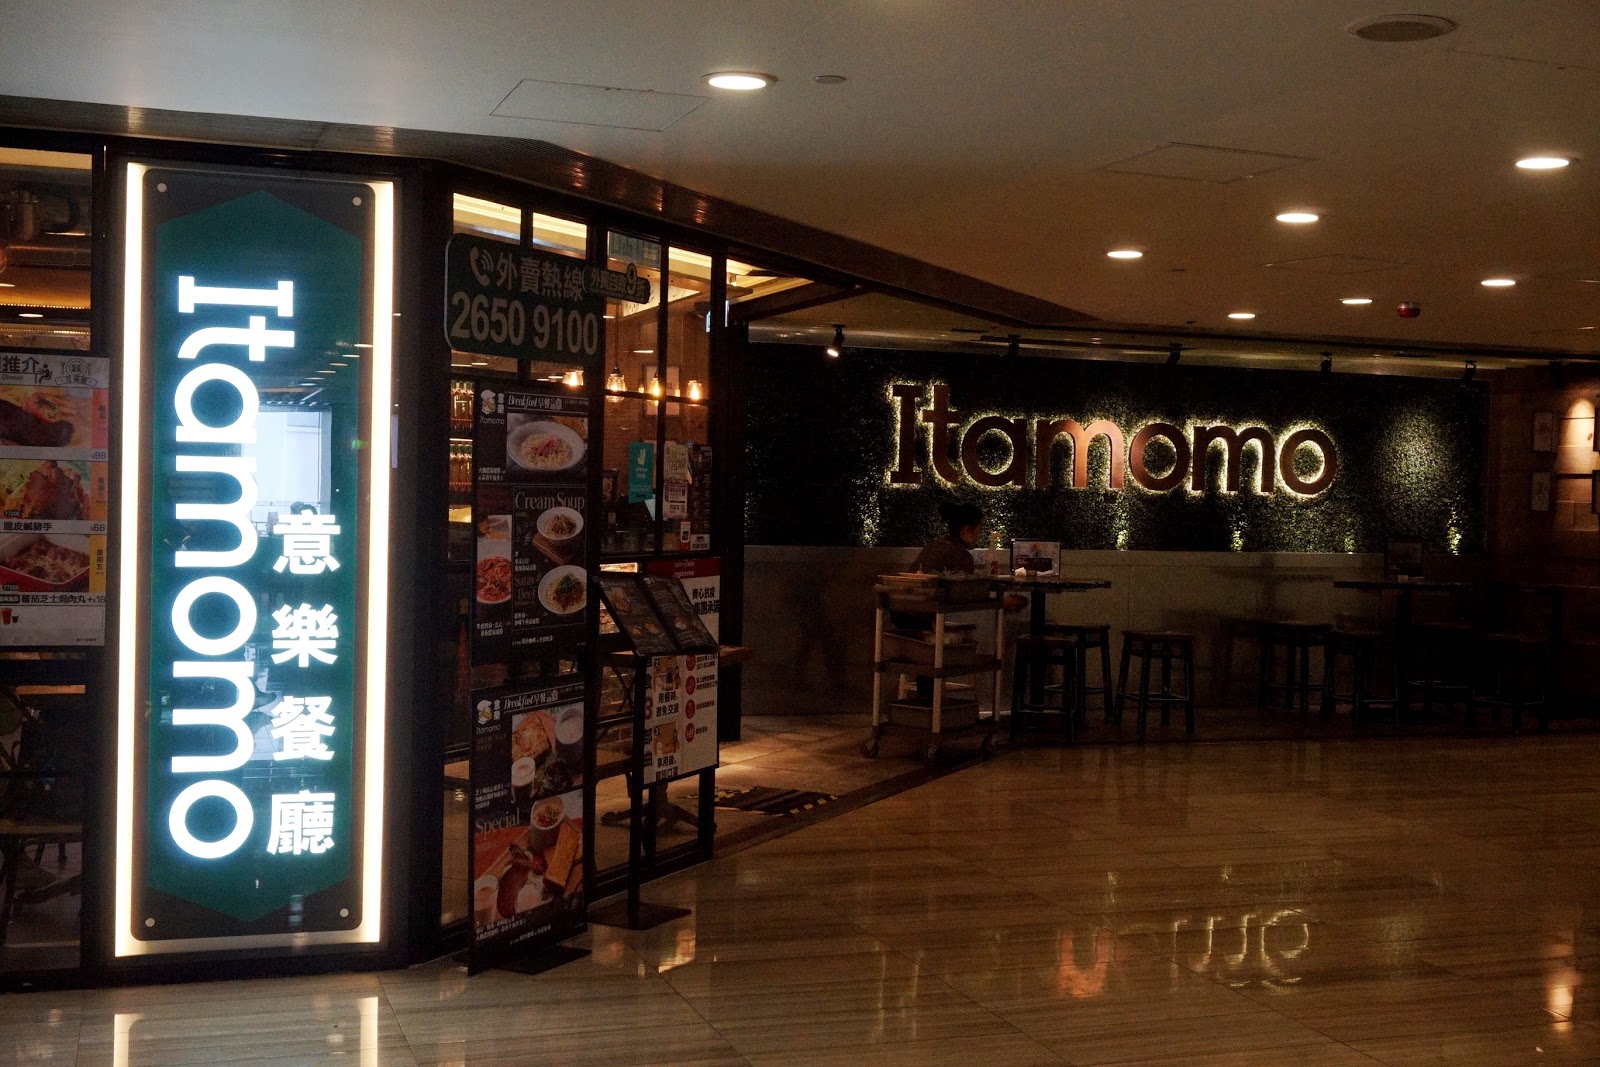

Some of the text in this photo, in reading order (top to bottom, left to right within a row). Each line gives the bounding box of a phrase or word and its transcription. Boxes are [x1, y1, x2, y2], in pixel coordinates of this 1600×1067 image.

[497, 252, 584, 302] 外賣熱線
[450, 291, 599, 355] 2650 9100
[0, 355, 40, 374] 推介
[889, 384, 1338, 496] Itamomo
[515, 491, 585, 514] Cream Soup
[169, 275, 295, 859] Itamomo
[266, 507, 341, 856] 意樂餐廳
[475, 808, 520, 836] Special
